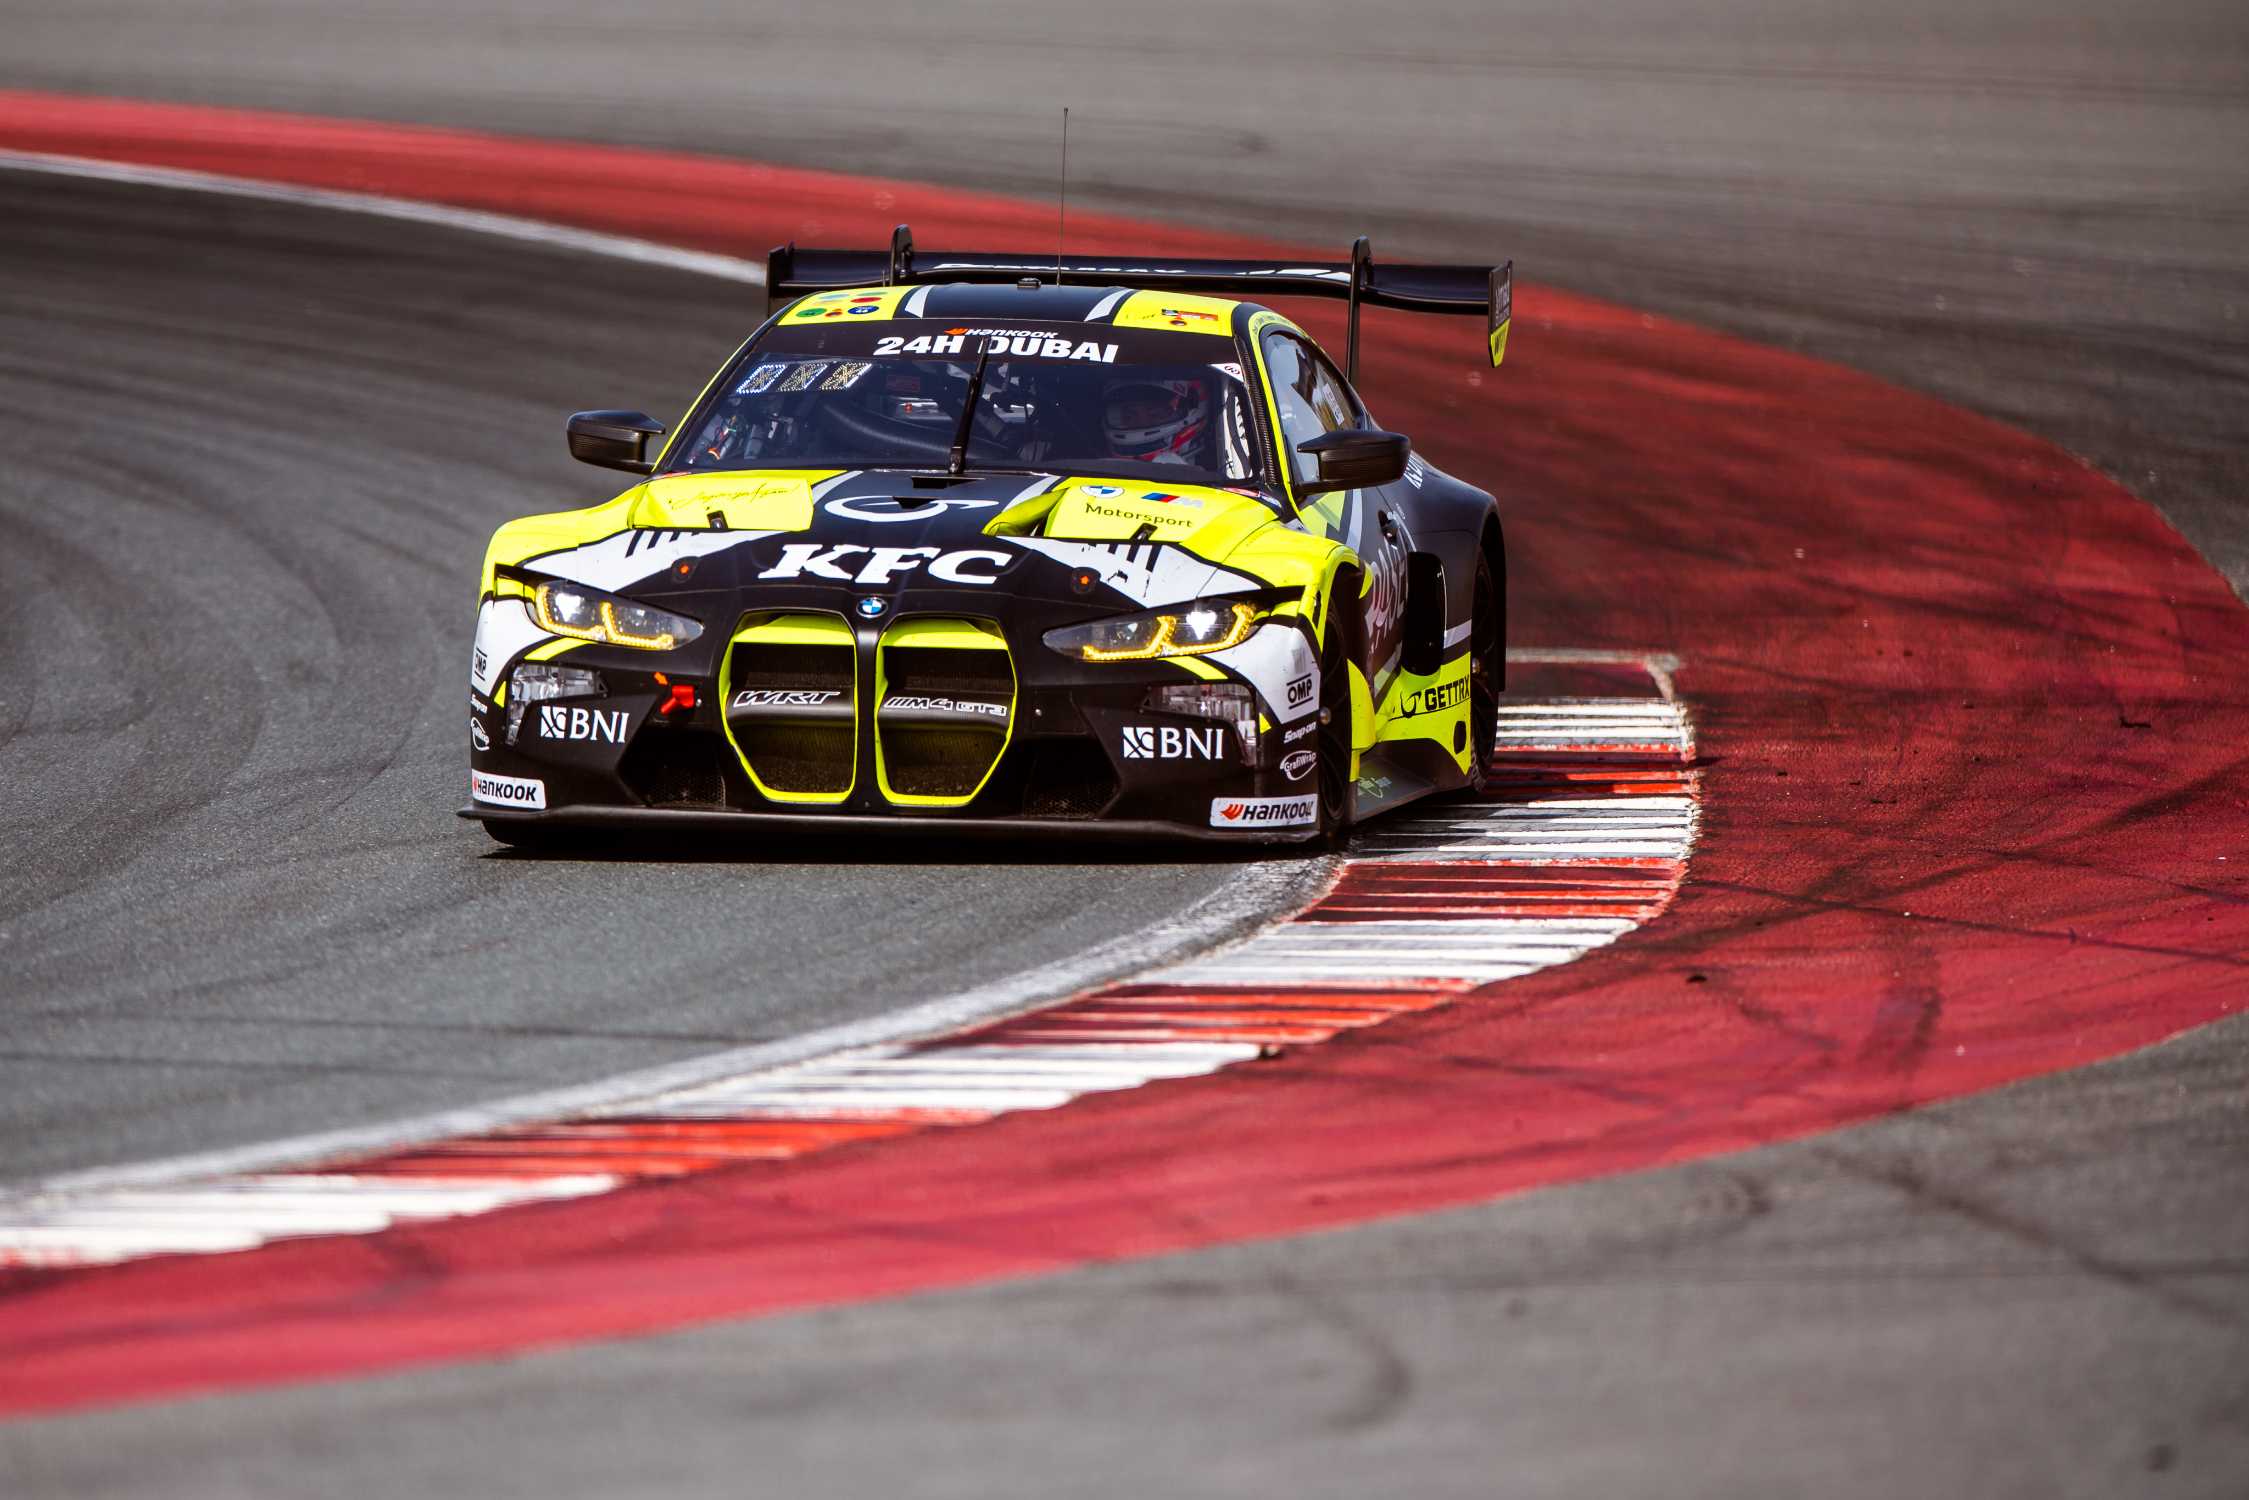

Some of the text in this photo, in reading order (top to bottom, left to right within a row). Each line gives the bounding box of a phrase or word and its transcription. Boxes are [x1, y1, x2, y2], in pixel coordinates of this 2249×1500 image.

[872, 335, 1119, 364] 24H DUBAI
[1085, 503, 1193, 529] Motorsport
[758, 544, 1013, 585] KFC
[732, 690, 841, 708] WRT
[1288, 679, 1313, 704] OMP
[1425, 675, 1470, 712] GETTRX
[955, 701, 1007, 716] GT3
[569, 707, 630, 744] BNI
[1160, 726, 1225, 761] BNI
